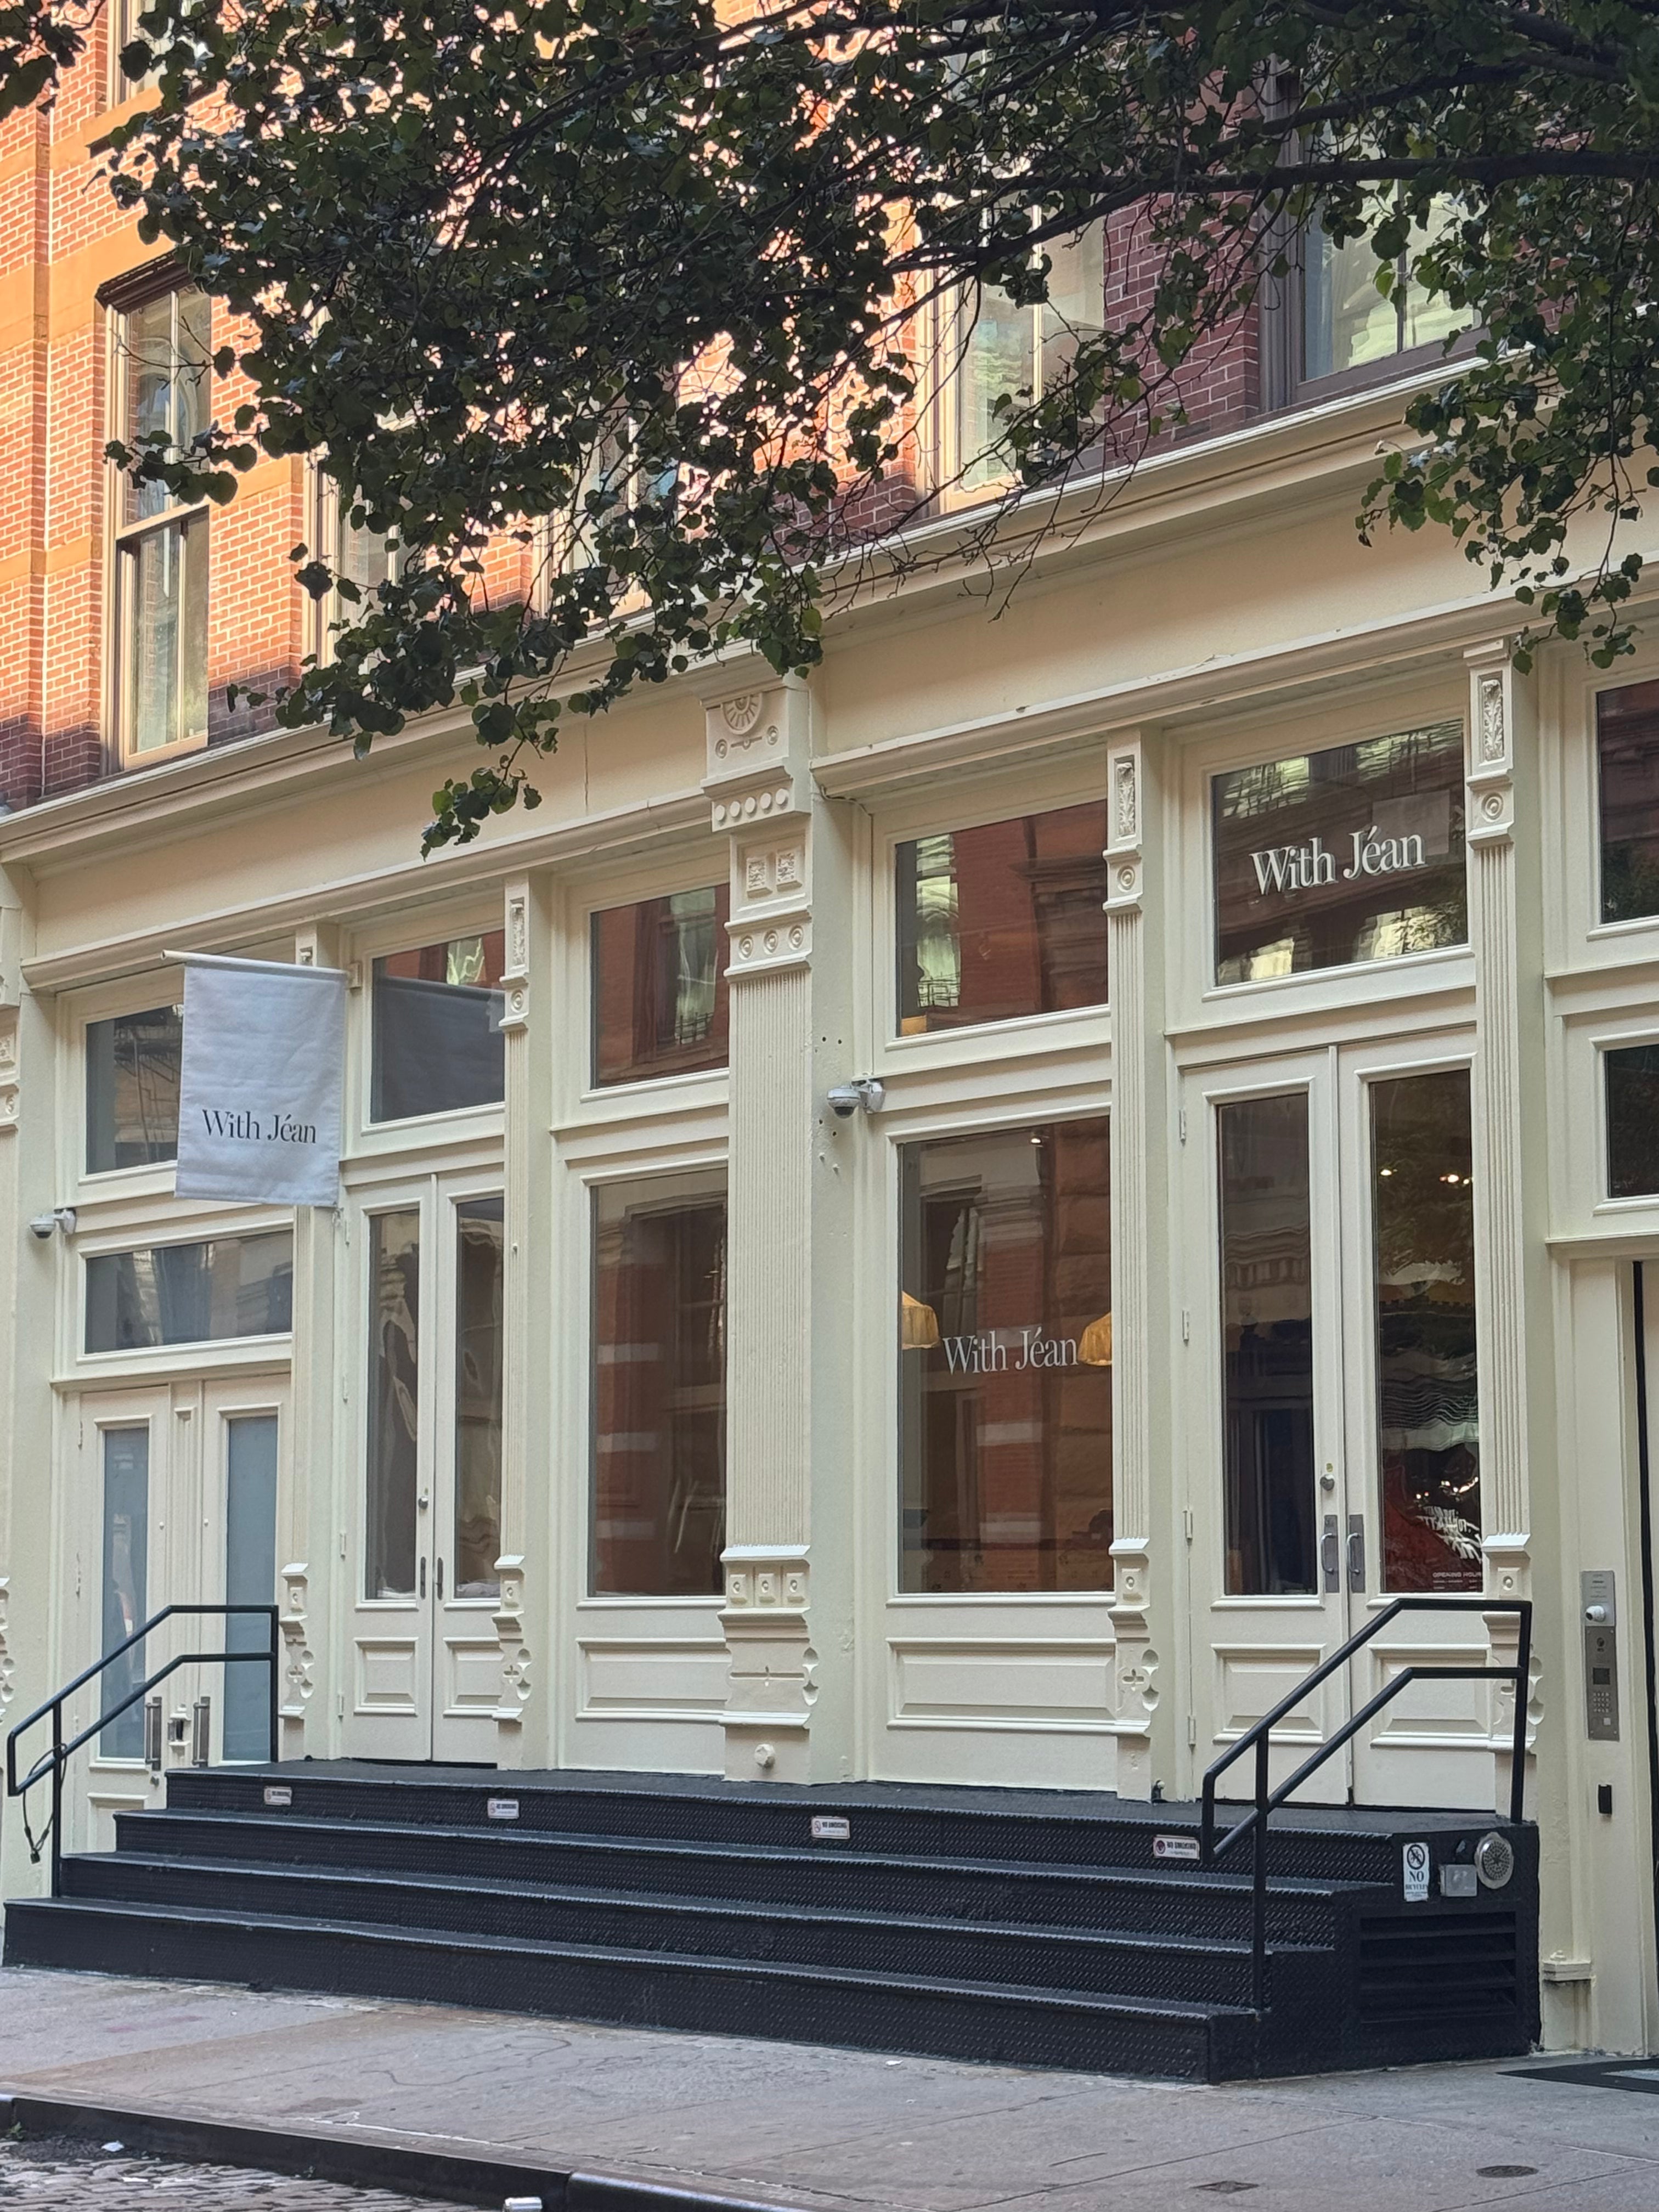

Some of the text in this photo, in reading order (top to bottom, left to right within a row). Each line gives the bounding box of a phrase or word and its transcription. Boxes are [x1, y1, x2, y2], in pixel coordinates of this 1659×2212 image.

[1249, 826, 1426, 895] With Jéan
[202, 1109, 316, 1144] With Jéan
[942, 1326, 1079, 1375] With Jéan
[1409, 1871, 1424, 1882] NO
